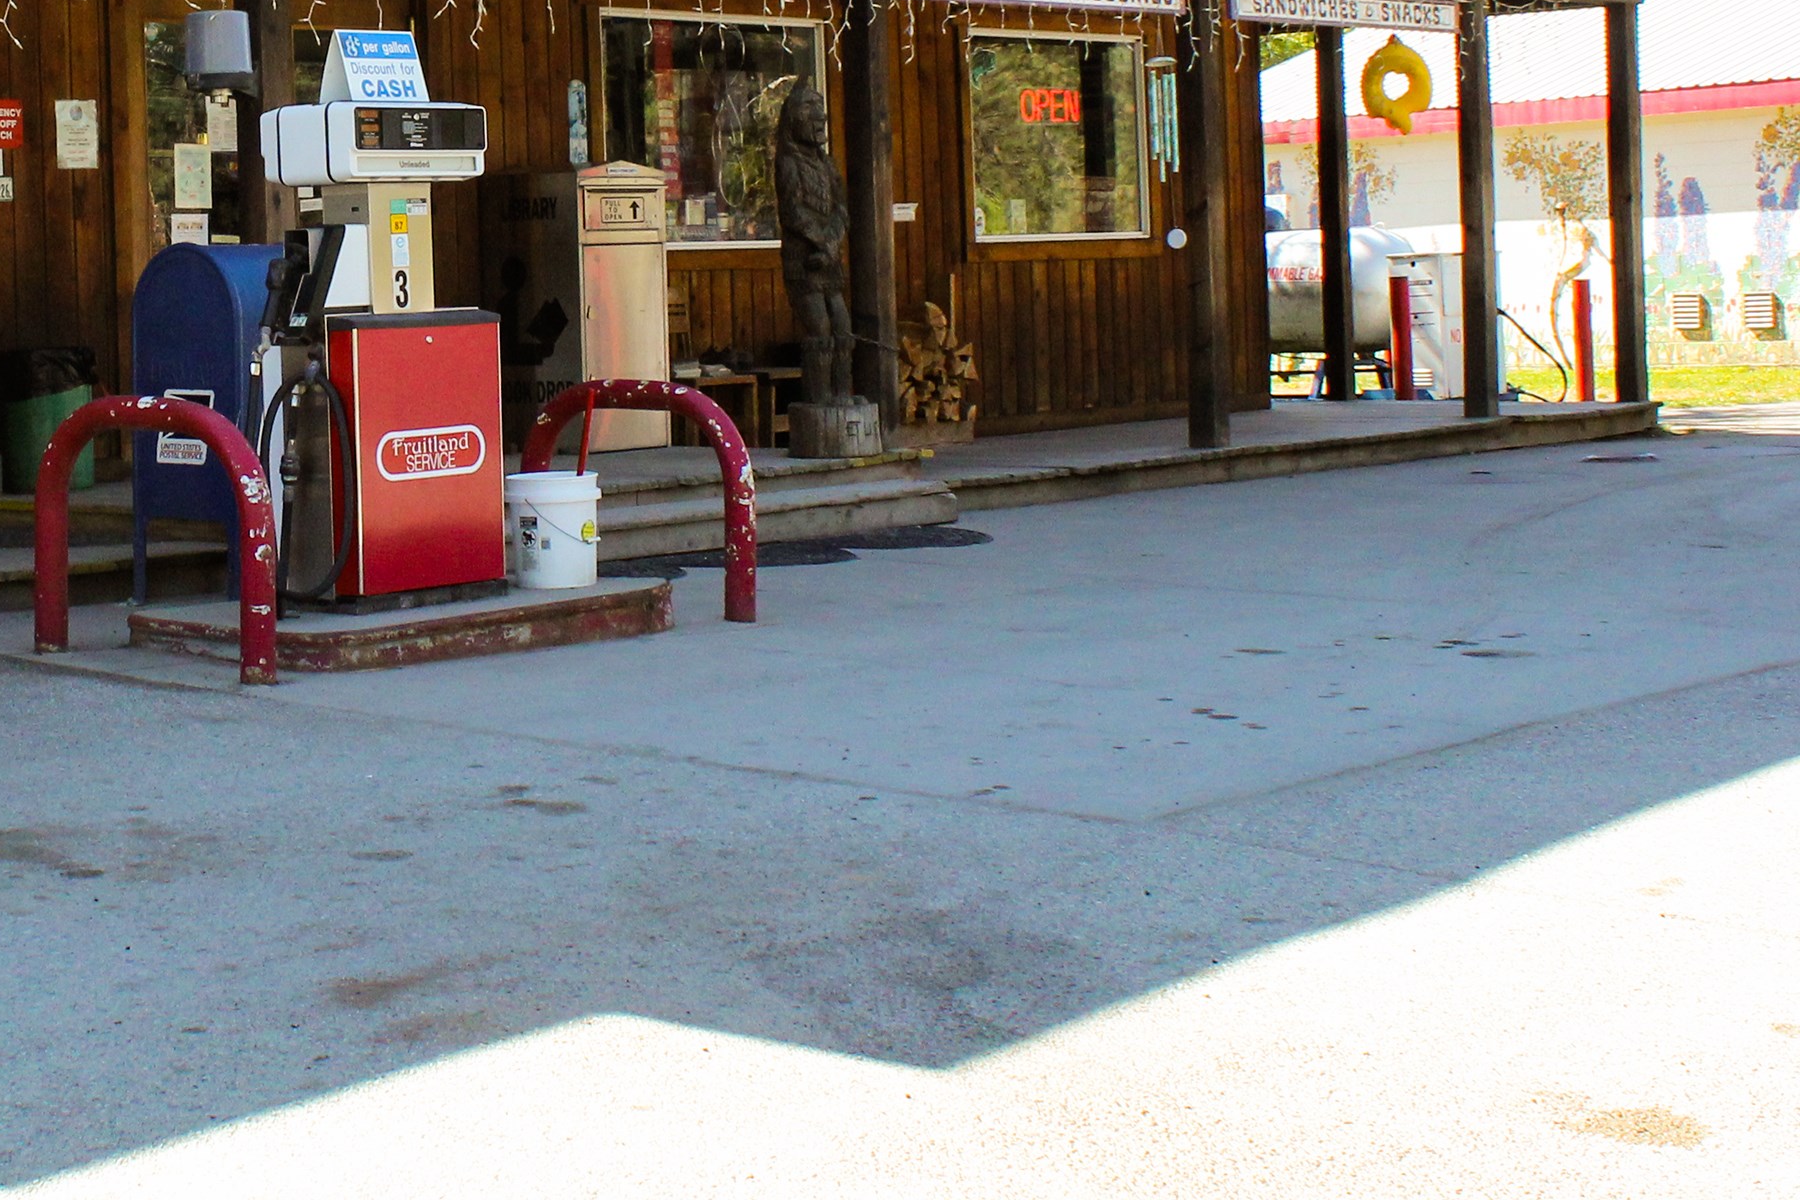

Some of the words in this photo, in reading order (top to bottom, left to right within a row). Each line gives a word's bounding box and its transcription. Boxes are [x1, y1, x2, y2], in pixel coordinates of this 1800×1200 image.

[1380, 2, 1441, 25] SNACKS
[362, 42, 378, 55] per
[381, 41, 411, 56] gallon
[350, 62, 397, 76] Discount
[400, 62, 415, 76] for
[361, 79, 417, 98] CASH
[1019, 88, 1081, 124] OPEN
[399, 161, 430, 169] Unleaded
[395, 270, 409, 308] 3
[160, 443, 182, 451] UNITED
[392, 432, 470, 457] Fruitland
[406, 450, 457, 473] SERVICE
